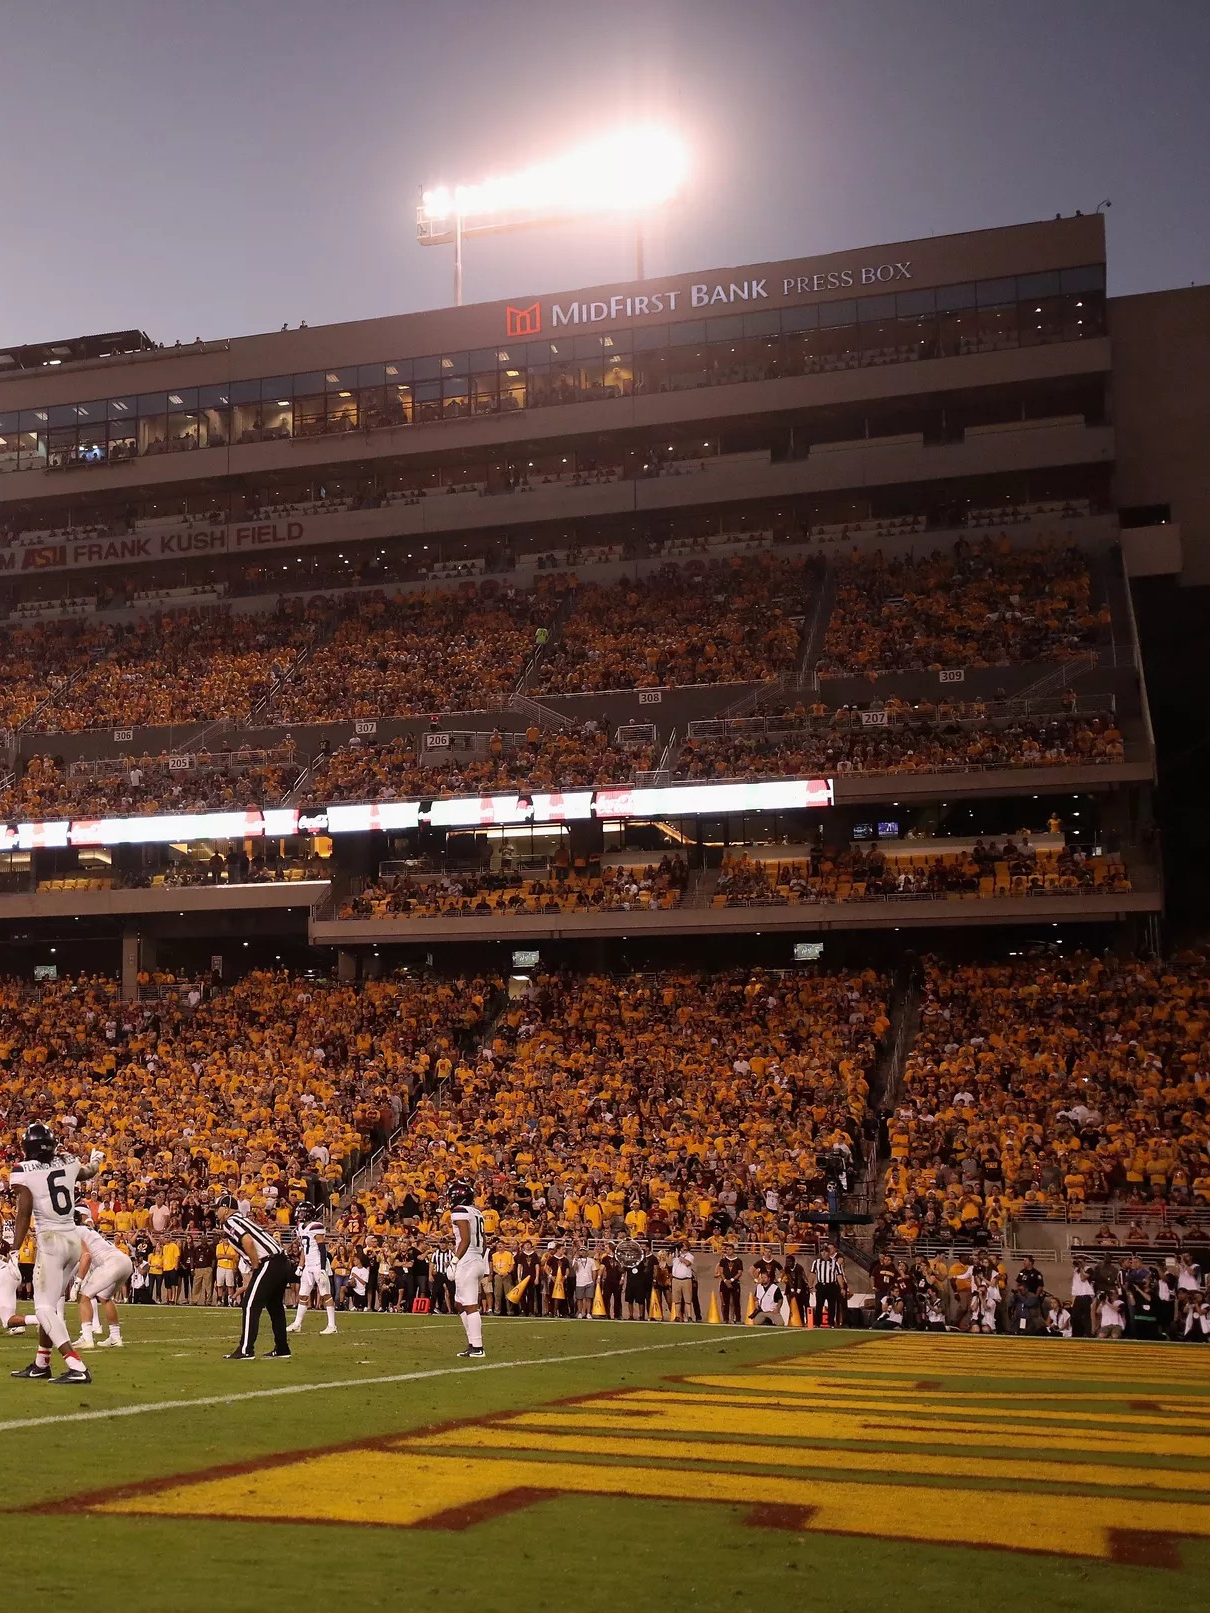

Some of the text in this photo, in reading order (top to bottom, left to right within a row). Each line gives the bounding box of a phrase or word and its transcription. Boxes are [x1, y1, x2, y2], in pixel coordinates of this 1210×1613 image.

[552, 262, 912, 327] MIDFIRST BANK PRESS BOX
[73, 538, 152, 563] FRANK
[160, 530, 226, 554] KUSH
[236, 522, 304, 546] FIELD
[941, 671, 963, 681] 309
[641, 693, 660, 703] 308
[865, 713, 886, 723] 207
[357, 723, 375, 733] 307
[116, 731, 132, 740] 306
[429, 735, 447, 745] 206
[170, 758, 187, 768] 205
[47, 1169, 72, 1216] 6
[349, 1222, 360, 1233] 12
[415, 1299, 426, 1312] 10
